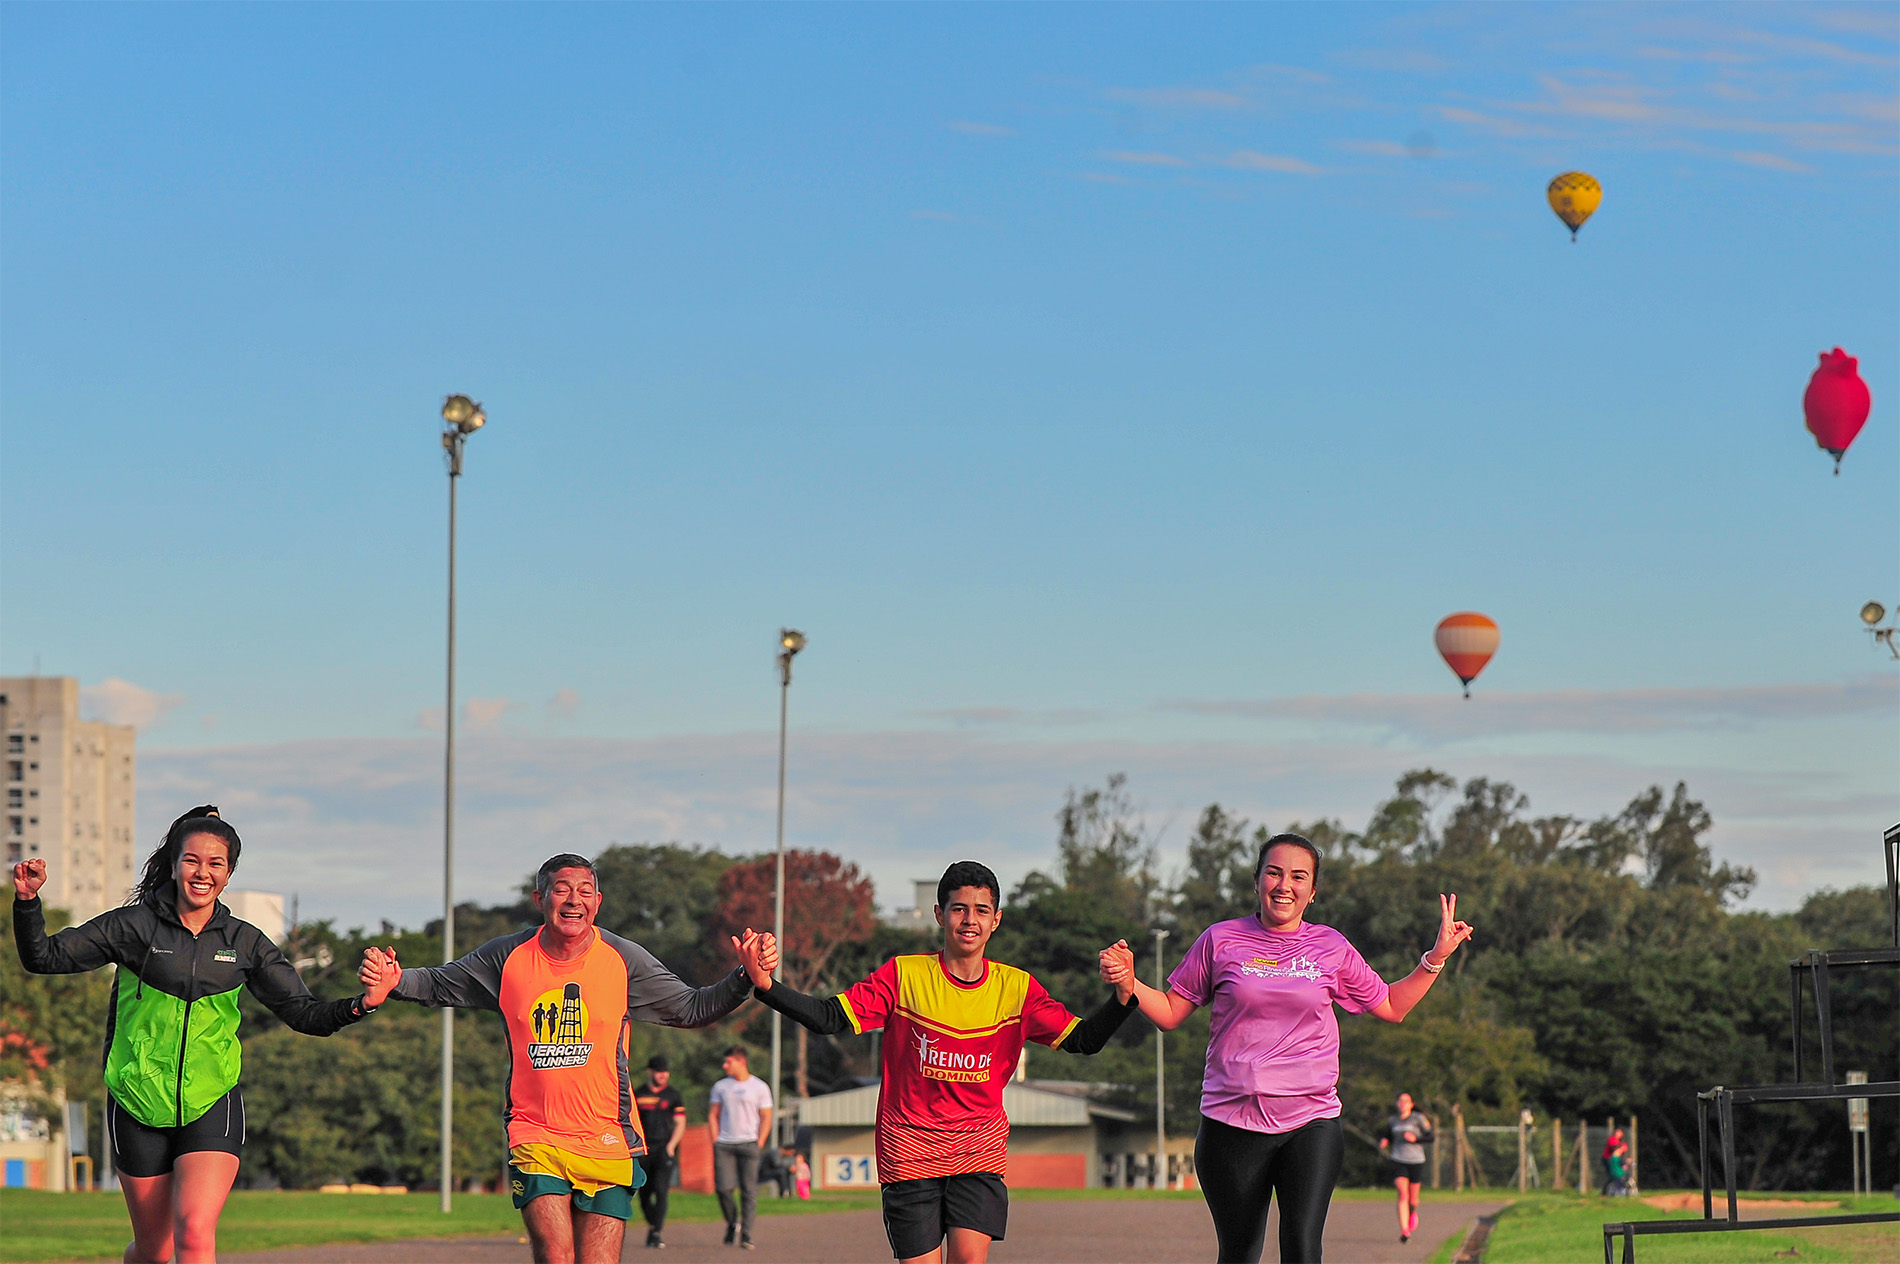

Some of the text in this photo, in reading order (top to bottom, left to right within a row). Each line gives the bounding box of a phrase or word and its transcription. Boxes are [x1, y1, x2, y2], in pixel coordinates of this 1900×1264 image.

[529, 1045, 592, 1058] VERACITY
[533, 1055, 588, 1068] RUNNERS
[838, 1158, 871, 1182] 31
